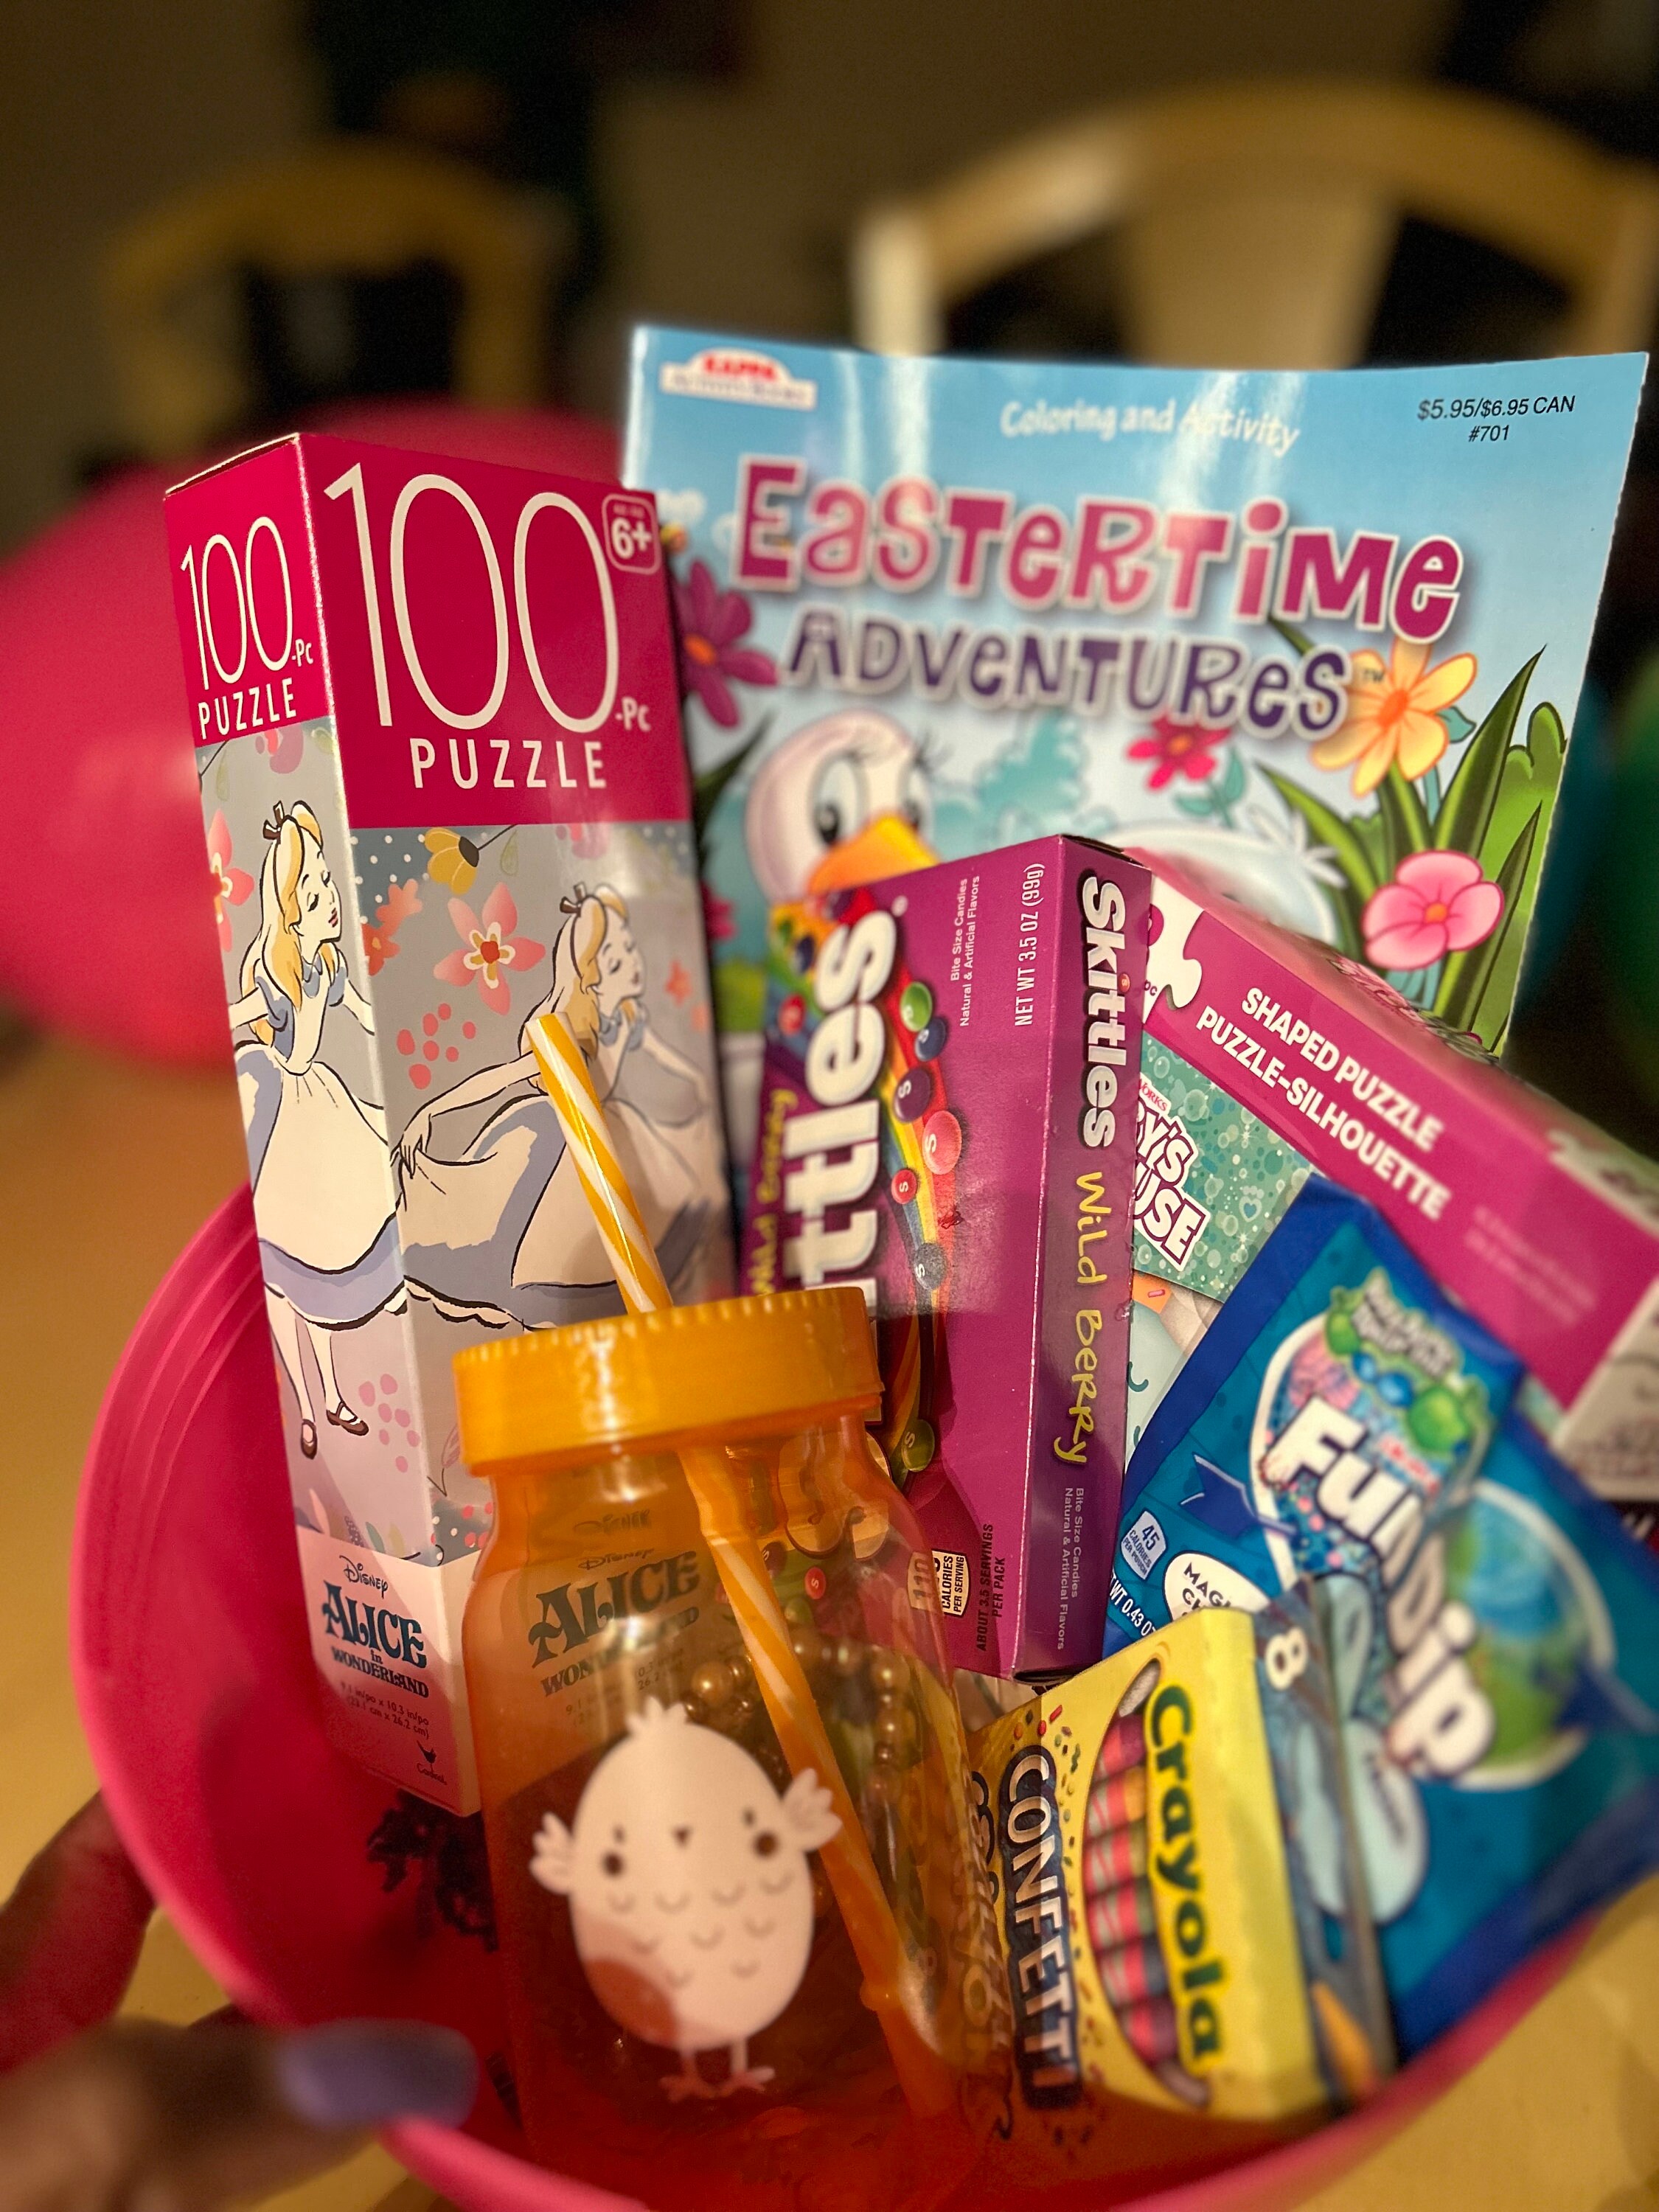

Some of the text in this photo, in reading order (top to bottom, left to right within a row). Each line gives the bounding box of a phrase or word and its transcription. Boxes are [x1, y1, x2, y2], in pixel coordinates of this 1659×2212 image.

[1000, 398, 1301, 459] Coloring and Activity
[1417, 395, 1576, 421] $5.95/$6.95 CAN
[1468, 425, 1509, 442] #701
[611, 516, 653, 559] 6+
[181, 515, 293, 691] 100
[324, 462, 619, 734] 100
[198, 676, 297, 740] PUZZLE
[410, 737, 607, 790] PUZZLE
[950, 877, 968, 981] Bite Size Candies
[959, 874, 981, 1028] Natural & Artificial Flavors
[1014, 863, 1046, 1028] NET WT 3.5 OZ (99g)
[1081, 874, 1131, 1148] Skittles
[1241, 987, 1444, 1152] SHAPED PUZZLE
[1196, 1005, 1452, 1222] PUZZLE-SILHOUETTE
[1133, 1161, 1207, 1265] USE
[1062, 1486, 1074, 1533] Natural
[1141, 1524, 1161, 1551] 45
[979, 1523, 994, 1585] SERVINGS
[1071, 1486, 1085, 1599] Bite Size Candies
[1121, 1537, 1133, 1554] PER
[1128, 1528, 1152, 1569] CALORIES
[941, 1555, 954, 1610] CALORIES
[953, 1556, 965, 1613] PER SERVING
[991, 1557, 1006, 1618] PER PACK
[1060, 1548, 1071, 1601] Artificial
[1108, 1579, 1129, 1606] WT
[1121, 1598, 1145, 1628] 0.43
[321, 1579, 428, 1669] ALICE
[528, 1550, 700, 1669] ALICE
[975, 1609, 989, 1652] ABOUT
[1057, 1603, 1069, 1651] Flavors
[331, 1645, 430, 1699] WONDERLAND
[370, 1649, 384, 1666] in
[1265, 1625, 1310, 1691] 8
[1150, 1685, 1225, 2062] Crayola
[1006, 1754, 1079, 2089] CONFETTI
